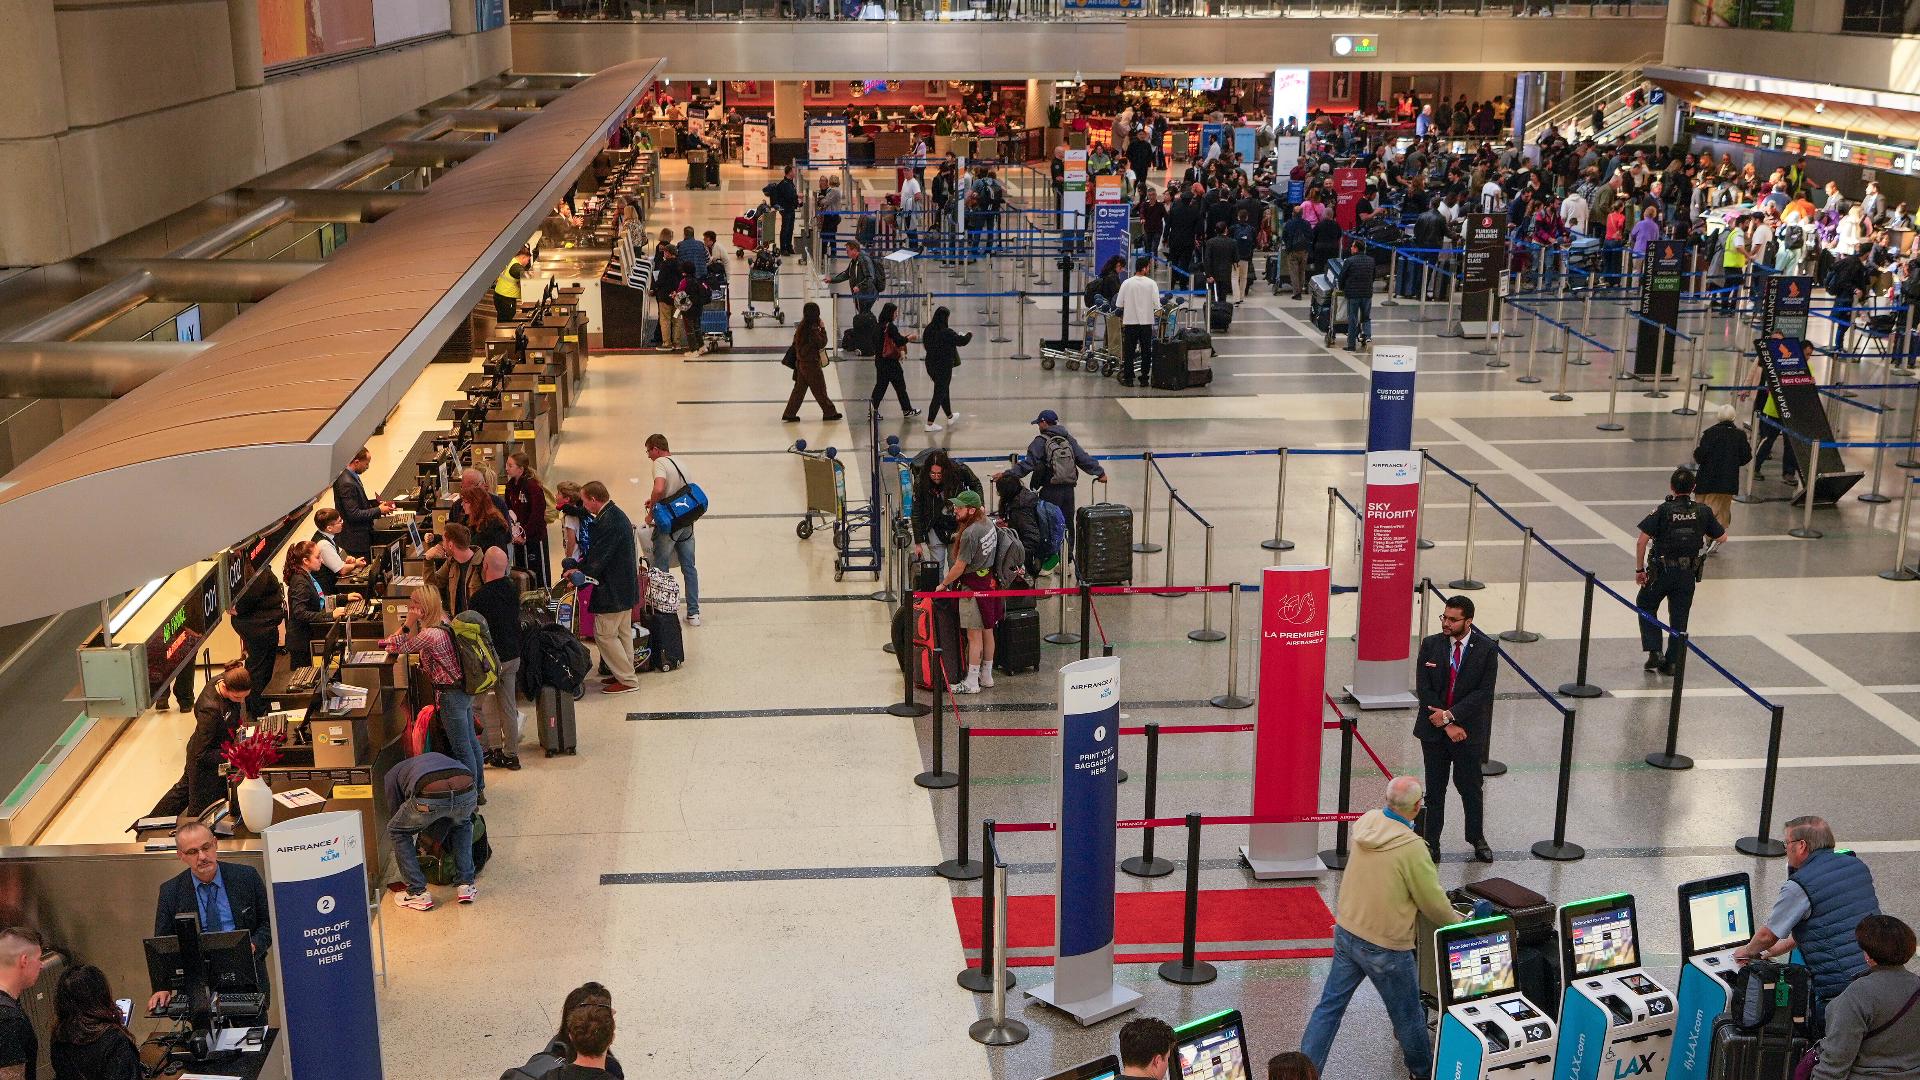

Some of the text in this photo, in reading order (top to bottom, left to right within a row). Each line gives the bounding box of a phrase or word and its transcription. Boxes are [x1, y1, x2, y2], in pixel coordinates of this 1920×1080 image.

[1643, 251, 1655, 314] STAR ALLIANCE
[1765, 287, 1777, 333] ALLIANCE
[1761, 350, 1791, 419] STAR ALLIANCE
[1368, 503, 1391, 511] SKY
[1367, 509, 1416, 519] PRIORITY
[1672, 512, 1697, 521] POLICE
[229, 558, 242, 588] C02
[204, 585, 217, 617] C01
[1286, 638, 1320, 646] AIRFRANCE
[1070, 679, 1109, 690] AIRFRANCE
[1079, 751, 1100, 762] PRINT
[1074, 757, 1107, 770] BAGGAGE
[1090, 765, 1107, 776] HERE
[276, 839, 332, 853] AIRFRANCE
[320, 852, 340, 862] KLM
[321, 899, 330, 910] 2
[1617, 911, 1628, 919] LAX
[303, 920, 350, 938] DROP-OFF
[314, 933, 341, 946] YOUR
[1496, 934, 1507, 942] LAX
[306, 940, 352, 957] BAGGAGE
[318, 952, 344, 966] HERE
[1683, 1008, 1704, 1071] flyLAX.com
[1614, 1051, 1657, 1080] LAX
